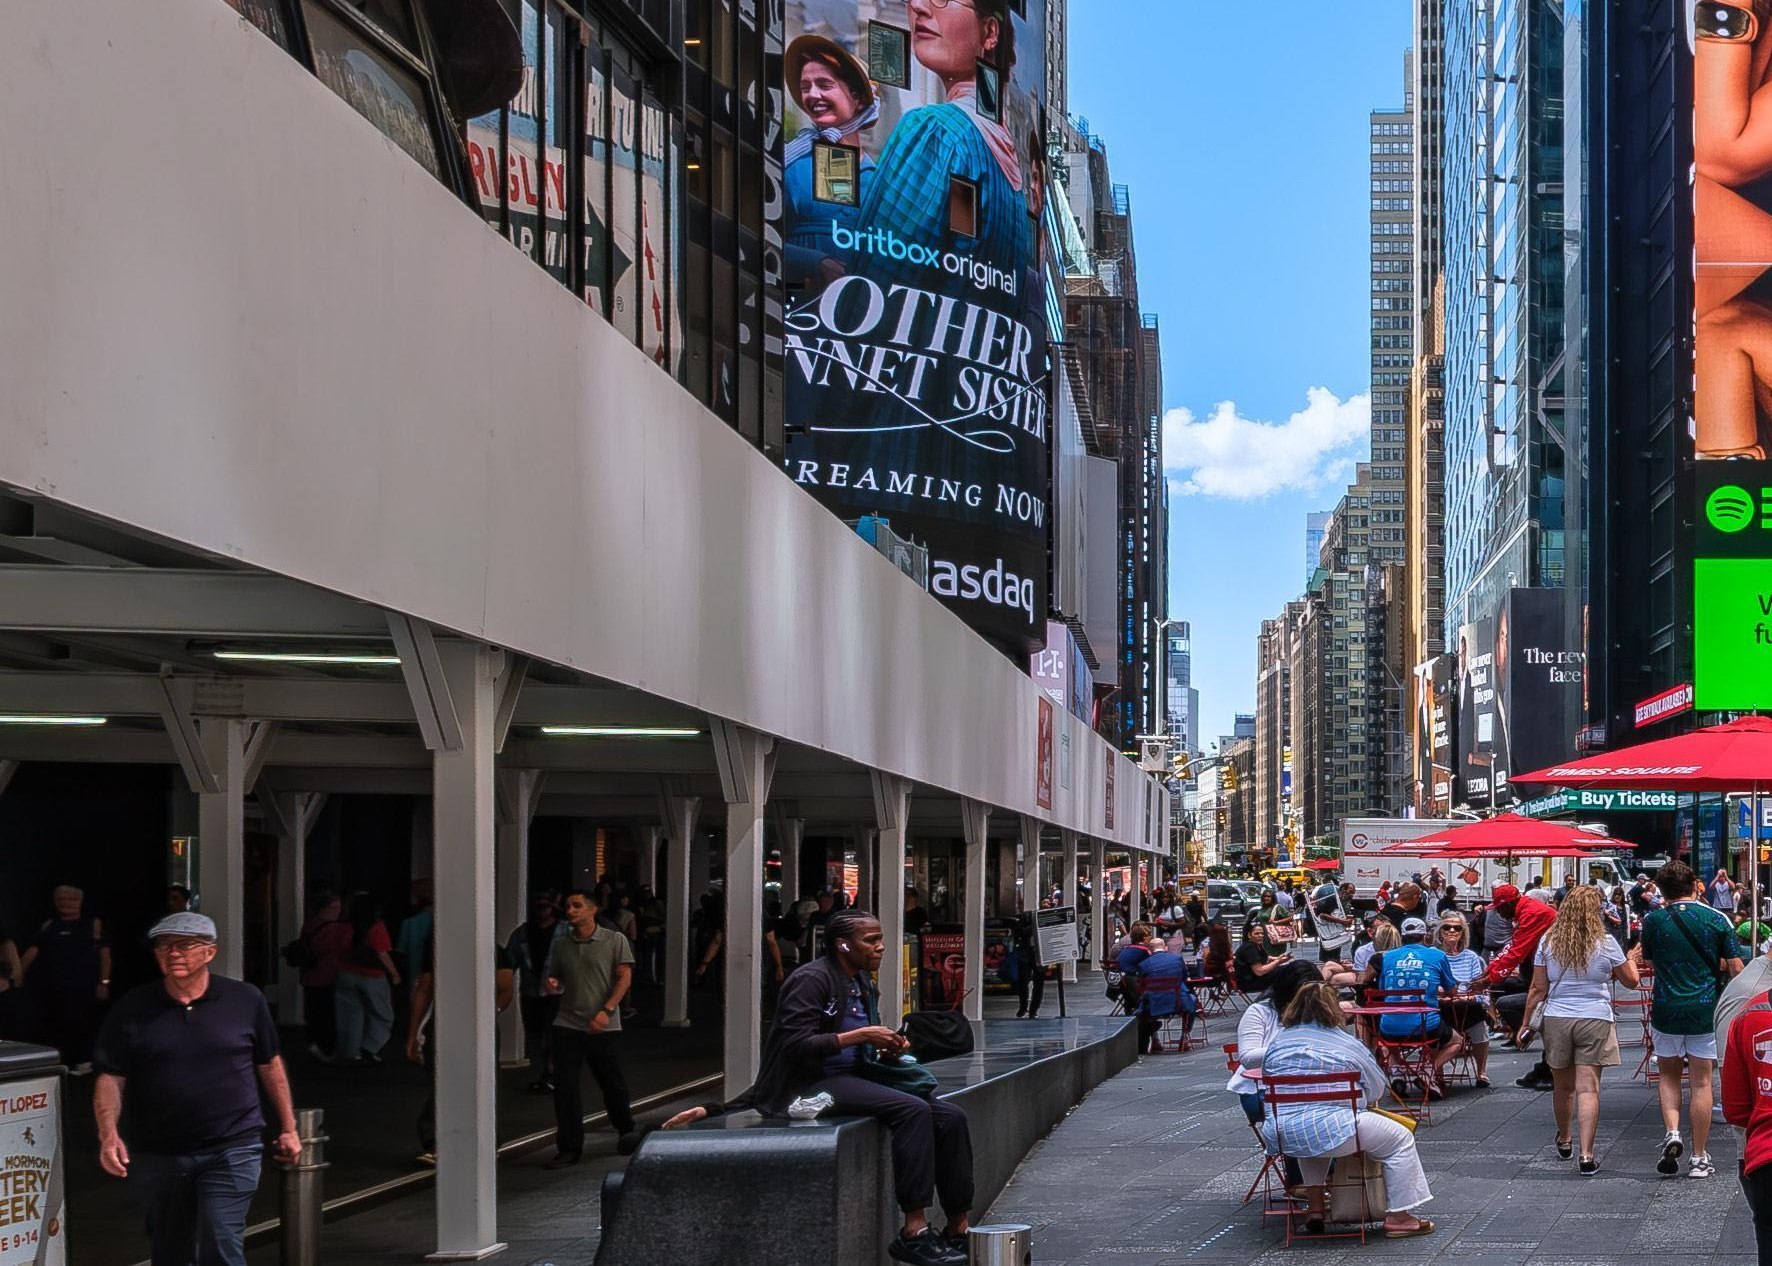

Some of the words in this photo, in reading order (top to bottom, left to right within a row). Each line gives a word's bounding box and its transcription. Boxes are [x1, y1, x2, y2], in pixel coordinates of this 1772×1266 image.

[831, 219, 939, 268] britbox
[943, 251, 1017, 297] original
[819, 275, 1035, 384] OTHER
[784, 459, 982, 507] REAMING
[995, 483, 1046, 530] NOW
[1523, 647, 1553, 664] The
[1550, 667, 1581, 682] face
[1546, 767, 1608, 777] TIMES
[1611, 766, 1702, 776] SQUARE
[1581, 792, 1615, 810] Buy
[1617, 791, 1676, 806] Tickets
[1396, 959, 1424, 968] ELITE
[10, 1092, 48, 1114] LOPEZ
[5, 1155, 50, 1170] MORMON
[14, 1230, 38, 1247] 9-14
